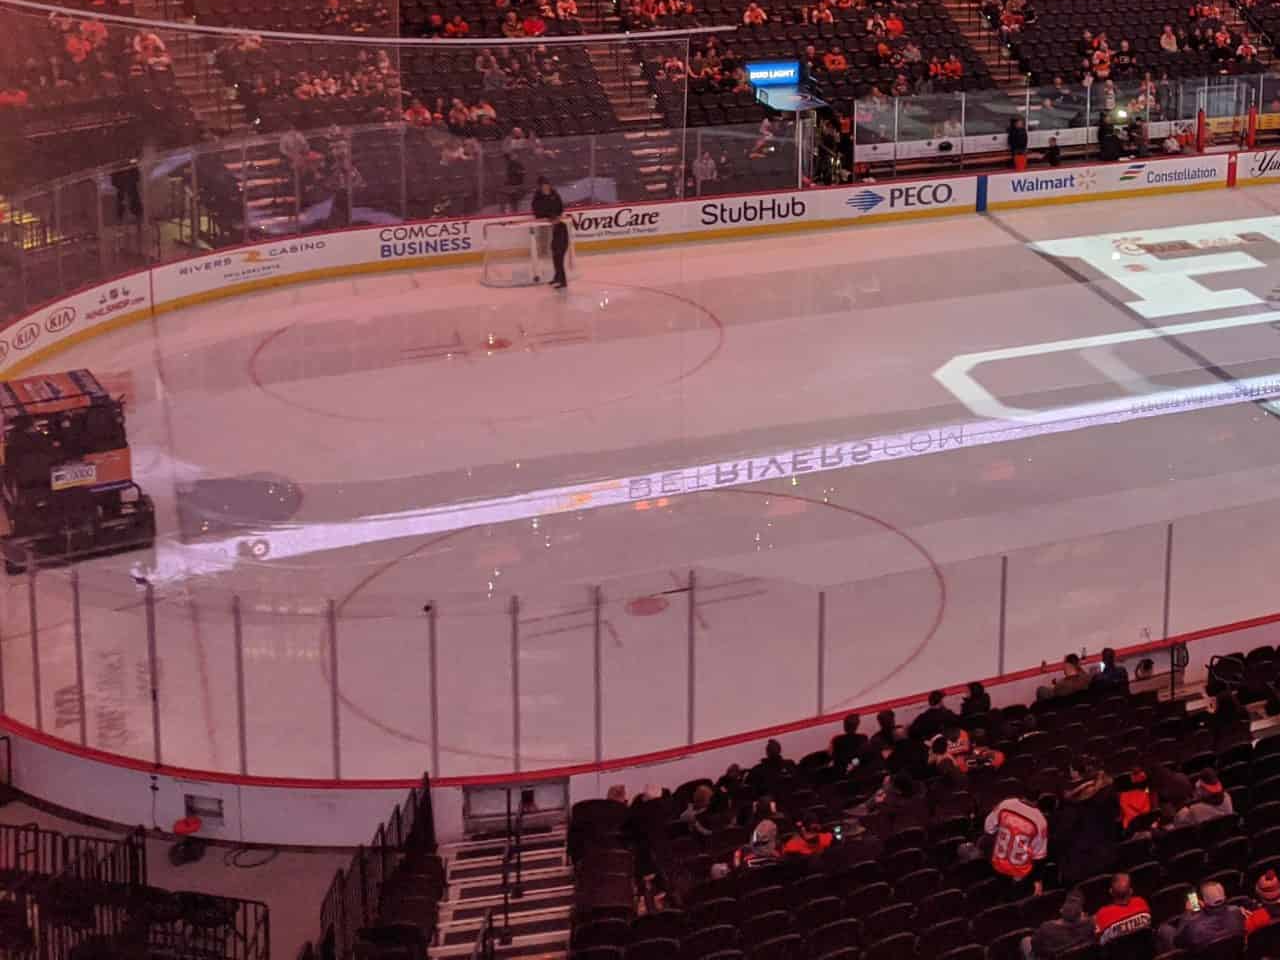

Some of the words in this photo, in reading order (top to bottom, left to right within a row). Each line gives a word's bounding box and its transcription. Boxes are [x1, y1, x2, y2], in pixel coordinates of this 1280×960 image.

[1010, 175, 1075, 194] Walmart
[1147, 166, 1217, 184] Constellation
[889, 183, 953, 208] PECO
[700, 196, 806, 225] StubHub
[379, 222, 470, 242] COMCAST
[179, 257, 233, 276] RIVERS
[268, 239, 326, 257] CASINO
[379, 237, 472, 258] BUSINESS
[48, 310, 73, 330] KIA
